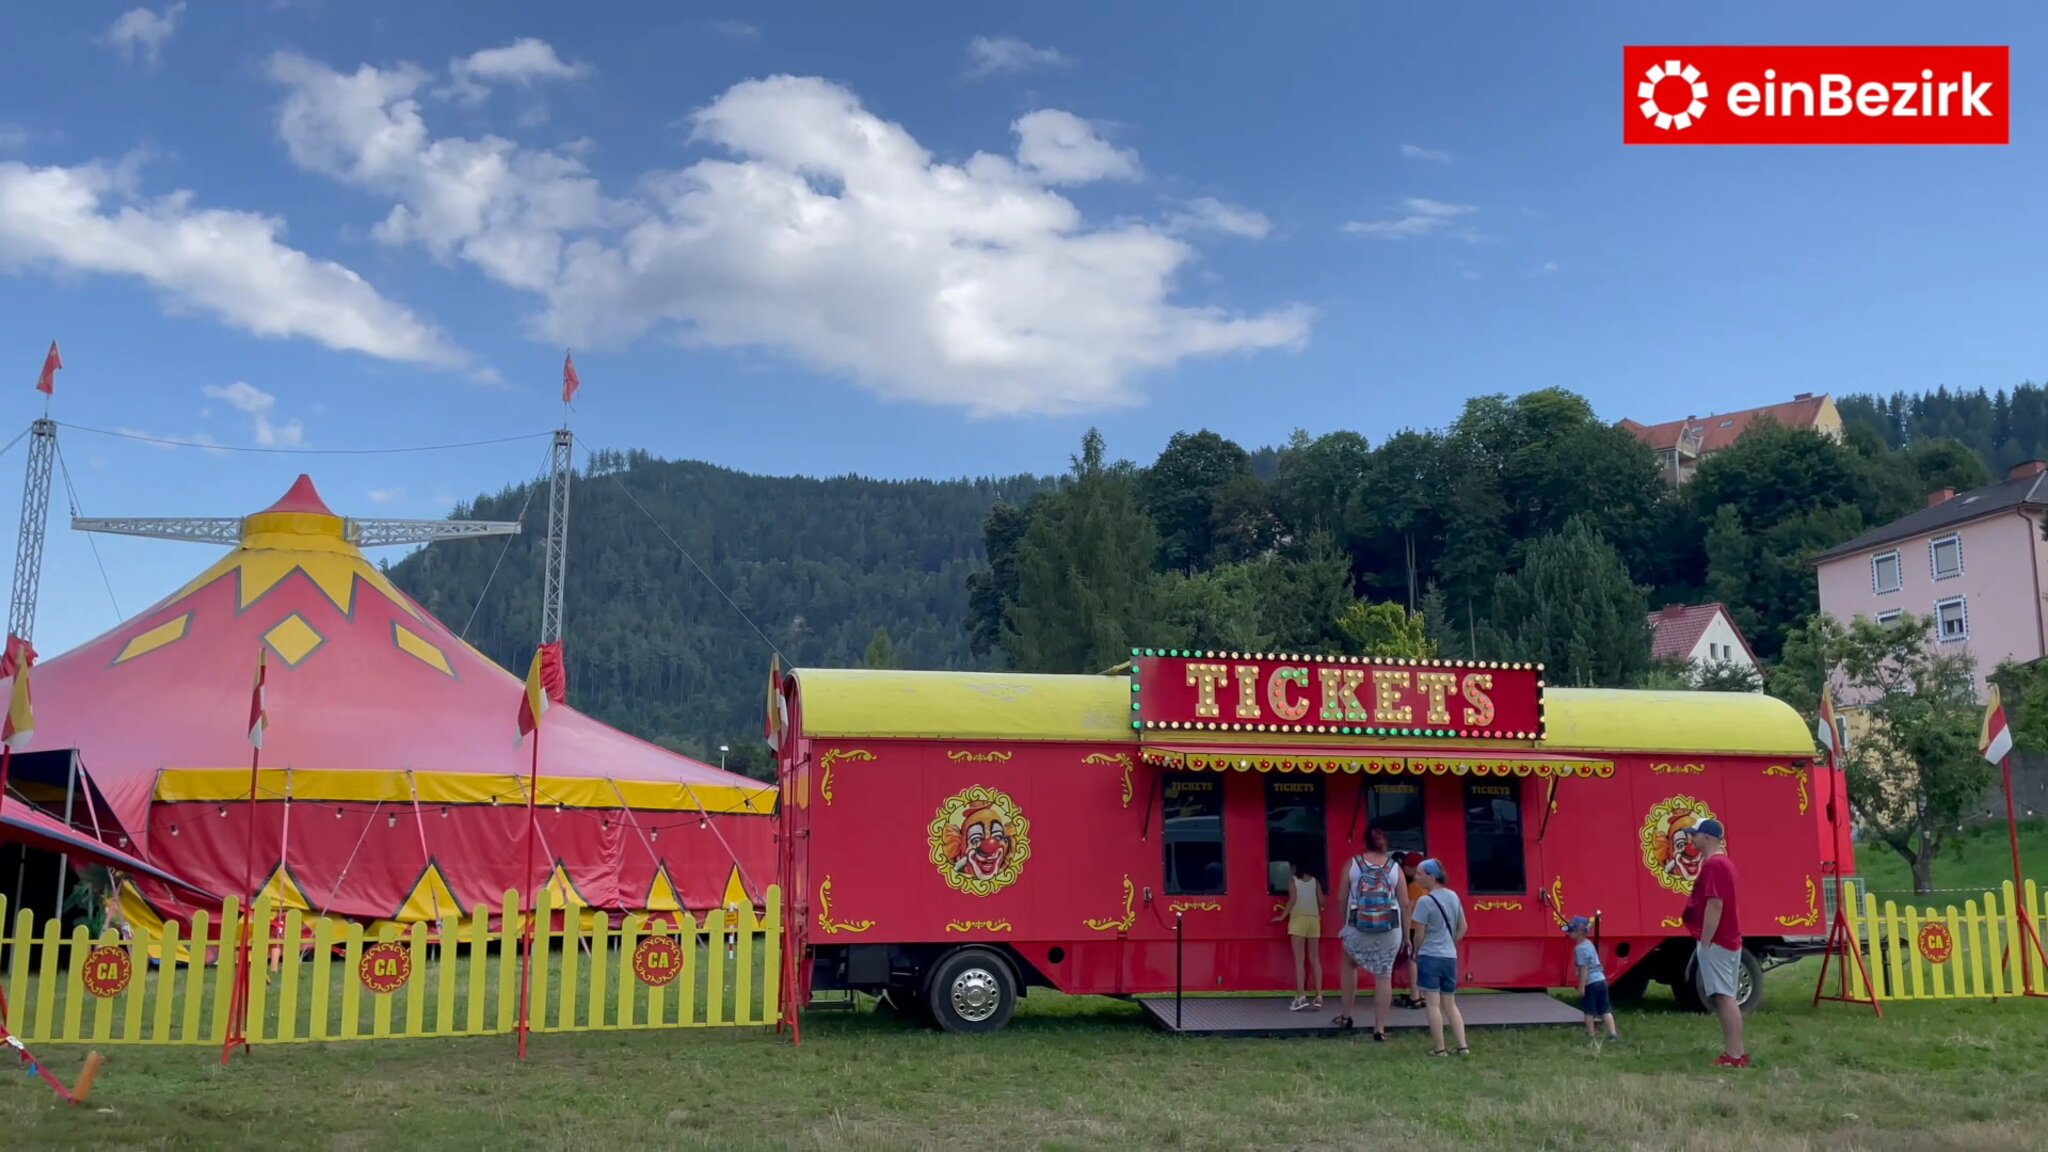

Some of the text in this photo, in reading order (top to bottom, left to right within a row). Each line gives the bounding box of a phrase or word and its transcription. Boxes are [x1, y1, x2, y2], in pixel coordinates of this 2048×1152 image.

[1185, 662, 1495, 726] TICKETS
[1172, 782, 1213, 791] TICKETS
[1274, 783, 1314, 792] TICKETS
[1472, 786, 1510, 795] TICKETS
[1927, 935, 1944, 949] CA
[374, 959, 398, 977] CA
[647, 952, 670, 969] CA
[97, 962, 118, 981] CA
